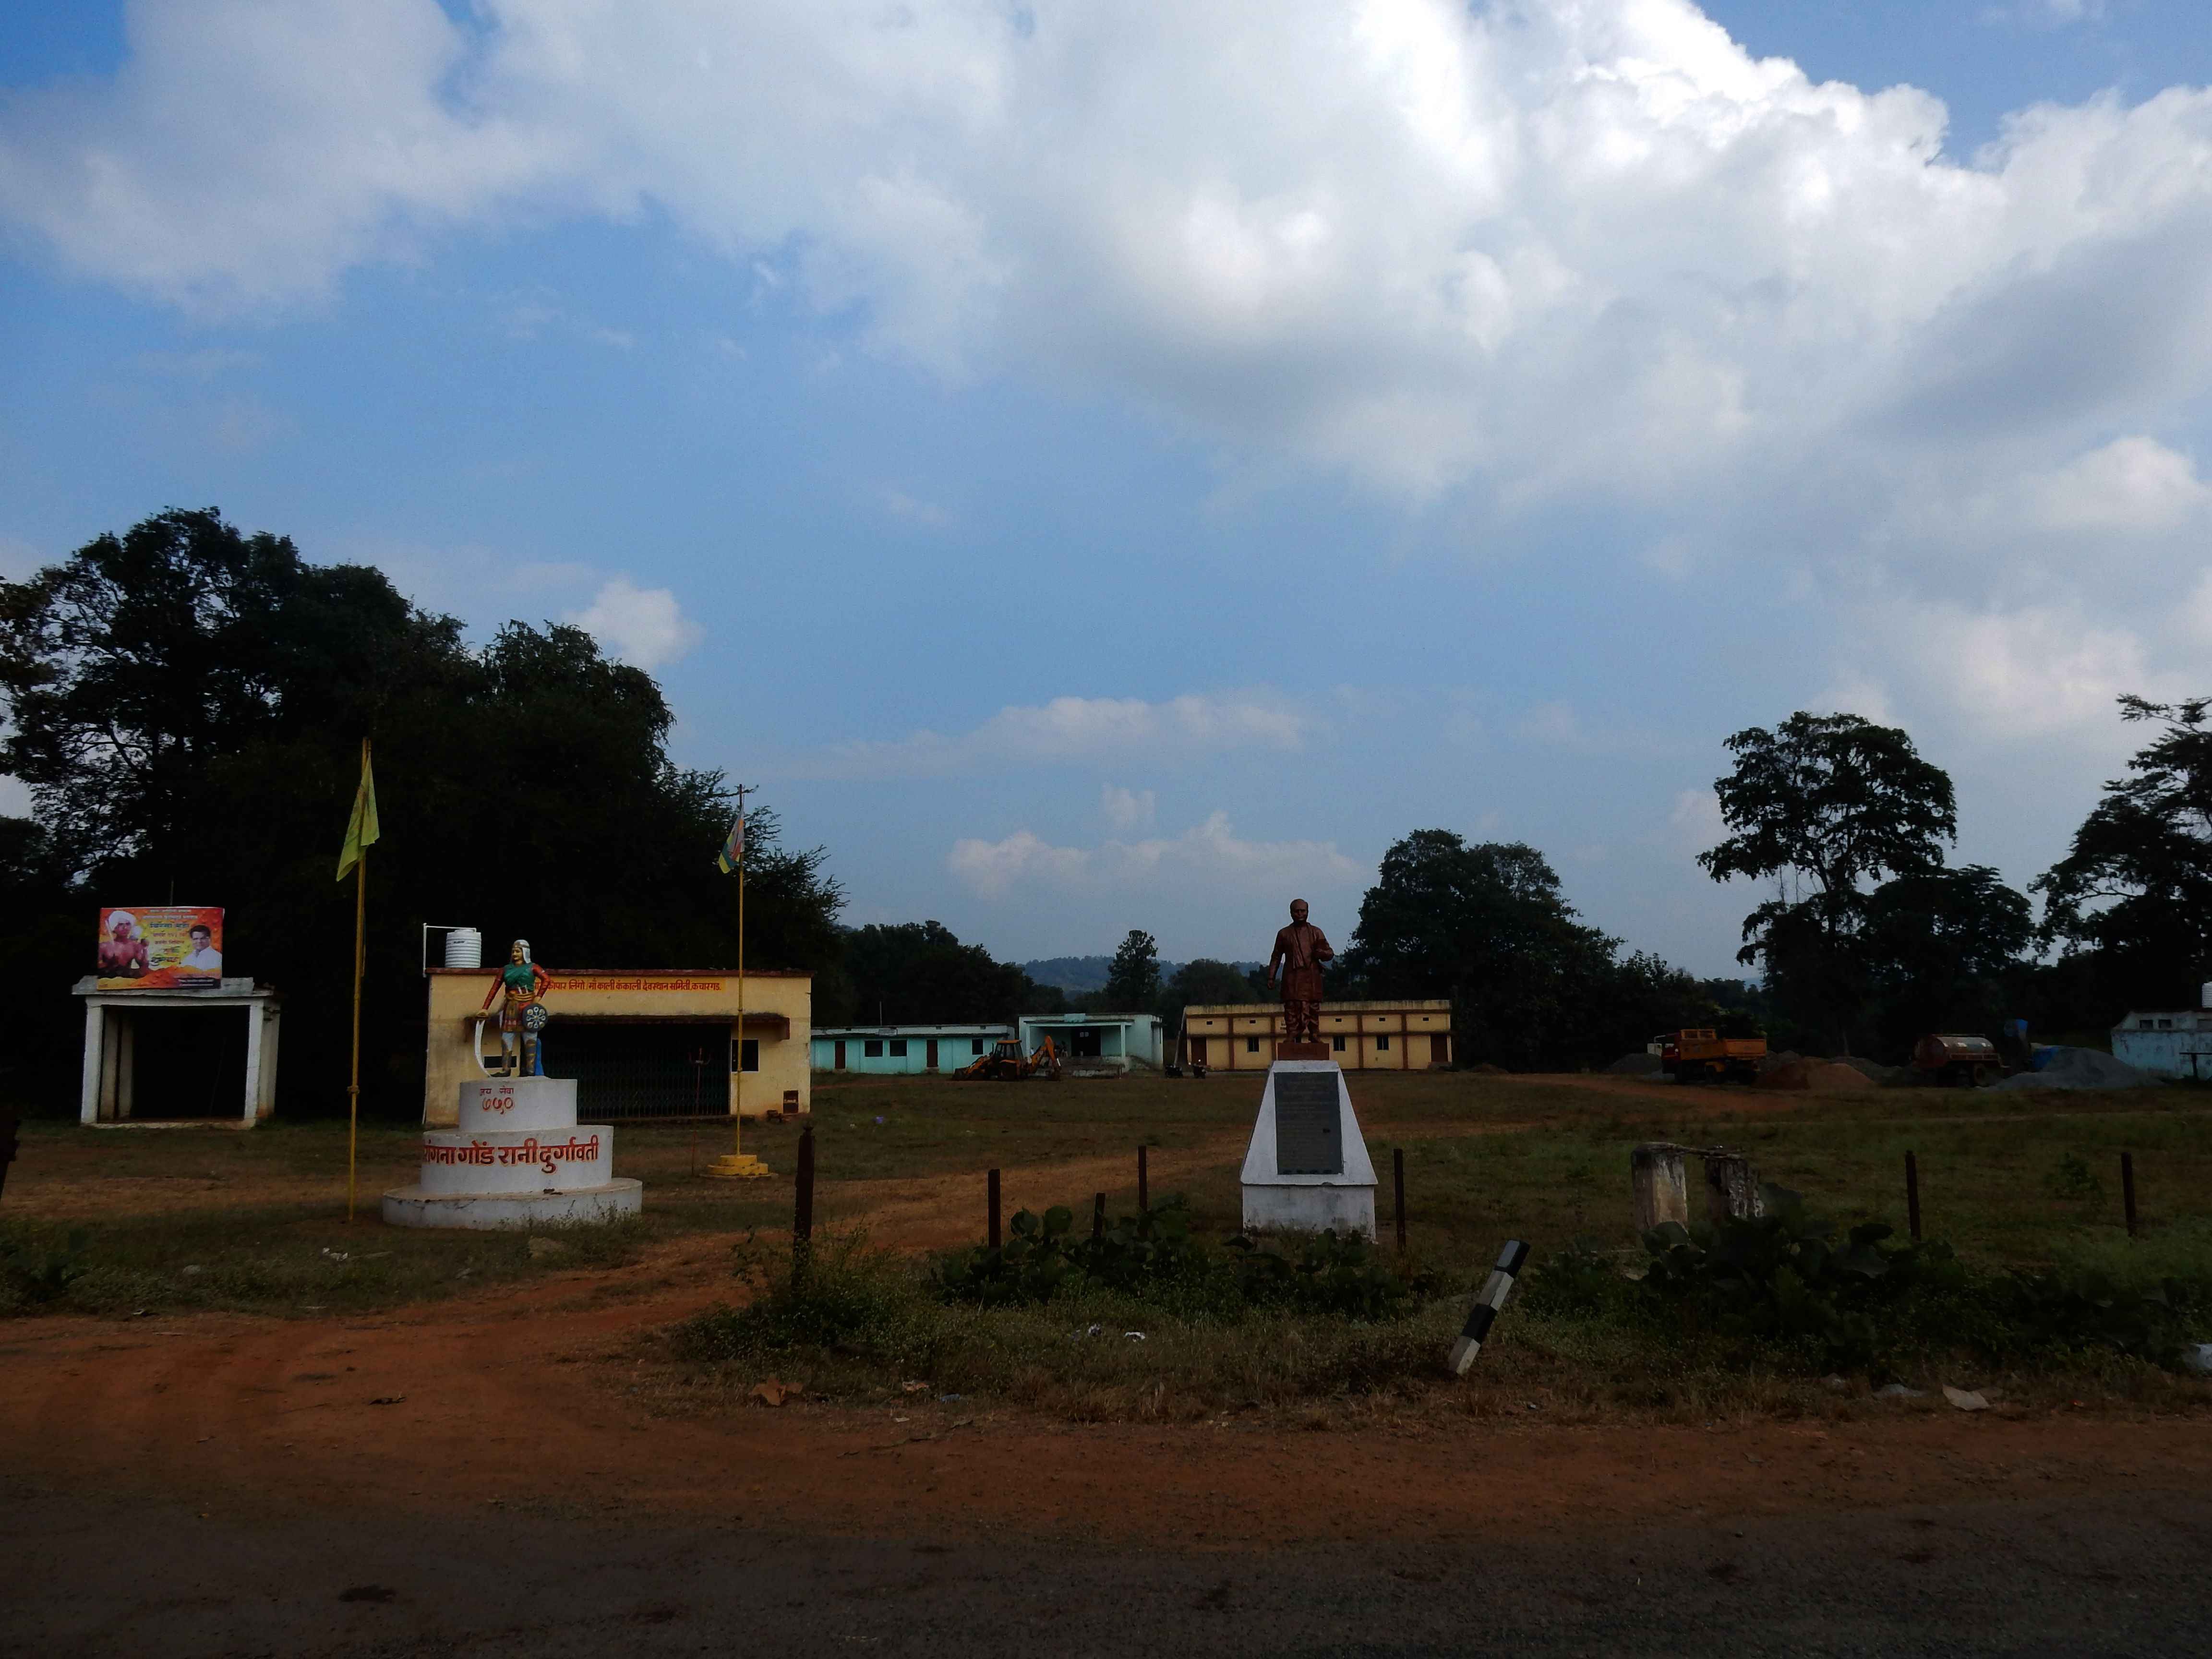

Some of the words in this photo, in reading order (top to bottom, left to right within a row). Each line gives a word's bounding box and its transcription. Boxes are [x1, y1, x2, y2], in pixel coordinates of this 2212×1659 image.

[598, 979, 614, 990] काली
[616, 979, 641, 990] कंकाली
[643, 979, 668, 991] देवस्थान
[499, 1085, 514, 1094] सेवा
[457, 1140, 495, 1165] गोंड
[498, 1137, 538, 1165] रानी
[539, 1134, 599, 1174] दुर्गावती
